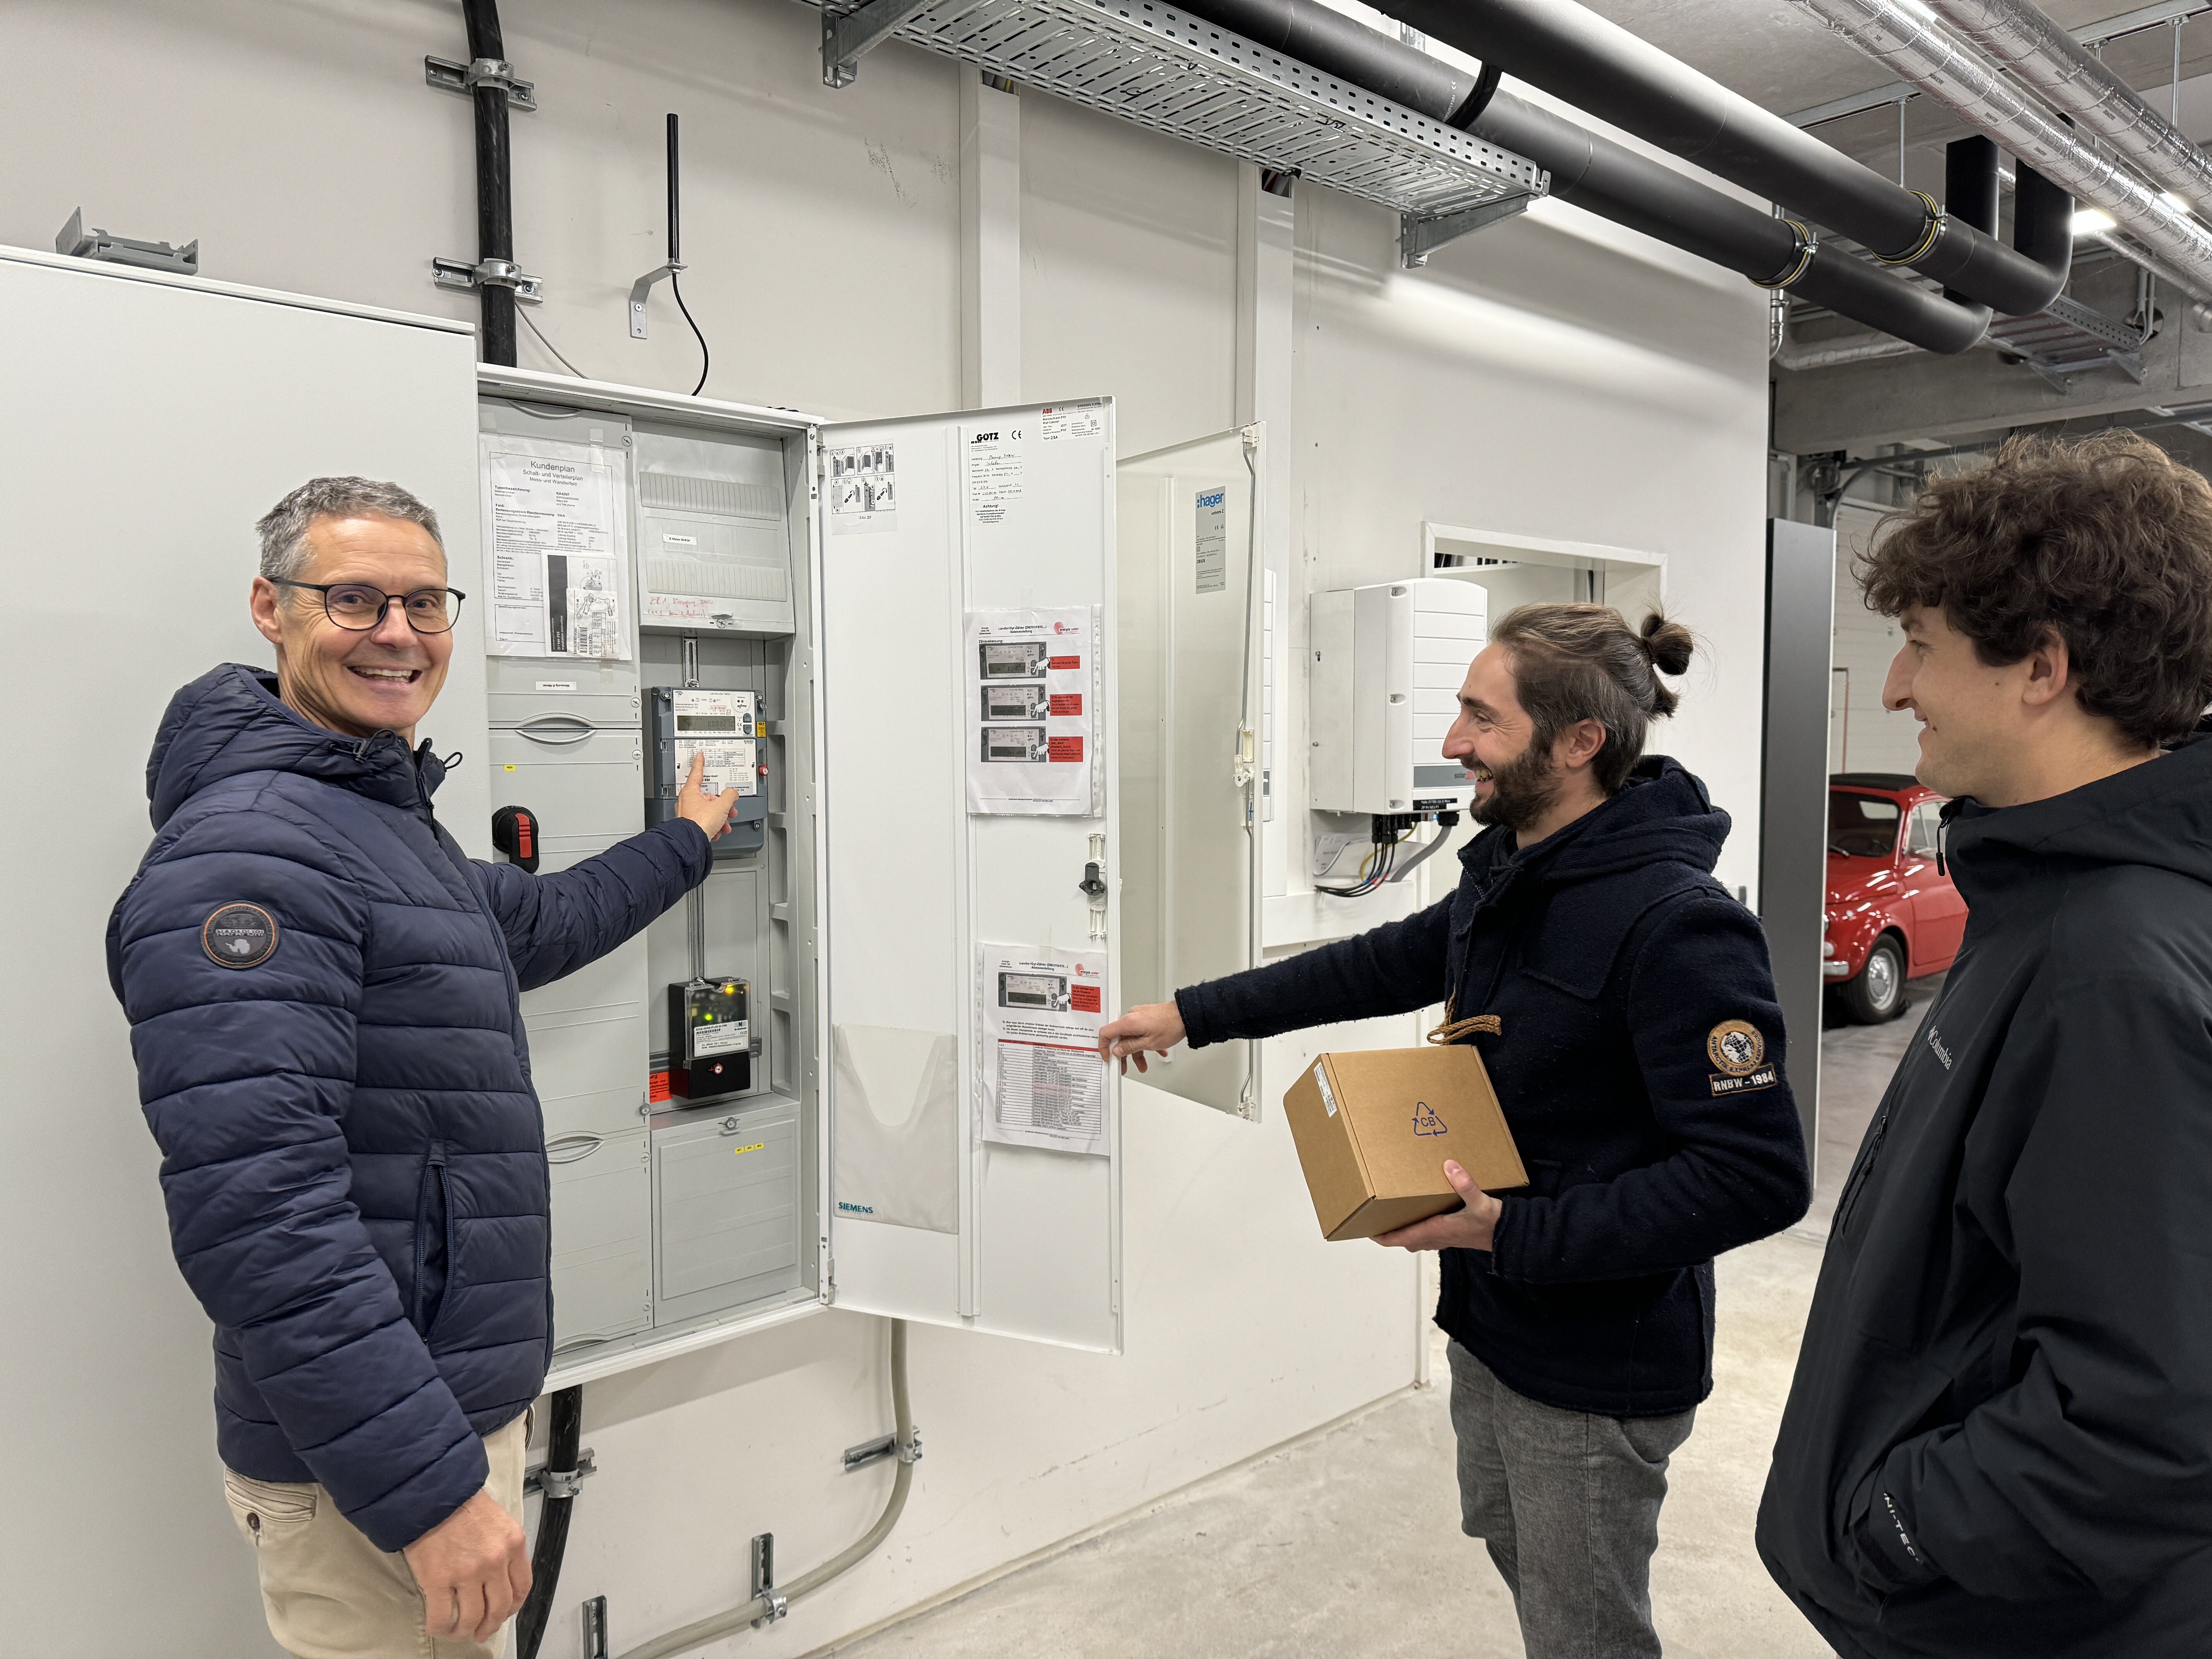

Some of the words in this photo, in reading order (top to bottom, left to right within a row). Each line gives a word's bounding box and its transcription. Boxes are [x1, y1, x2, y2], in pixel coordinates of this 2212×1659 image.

[531, 461, 575, 473] Kundenplan
[1711, 1035, 1729, 1070] ANTARCTIK
[1930, 1030, 1953, 1070] Columbia
[1713, 1078, 1743, 1091] RNBW
[1750, 1071, 1774, 1085] 1984
[1420, 1116, 1436, 1127] CB
[838, 1202, 873, 1214] SIEMENS
